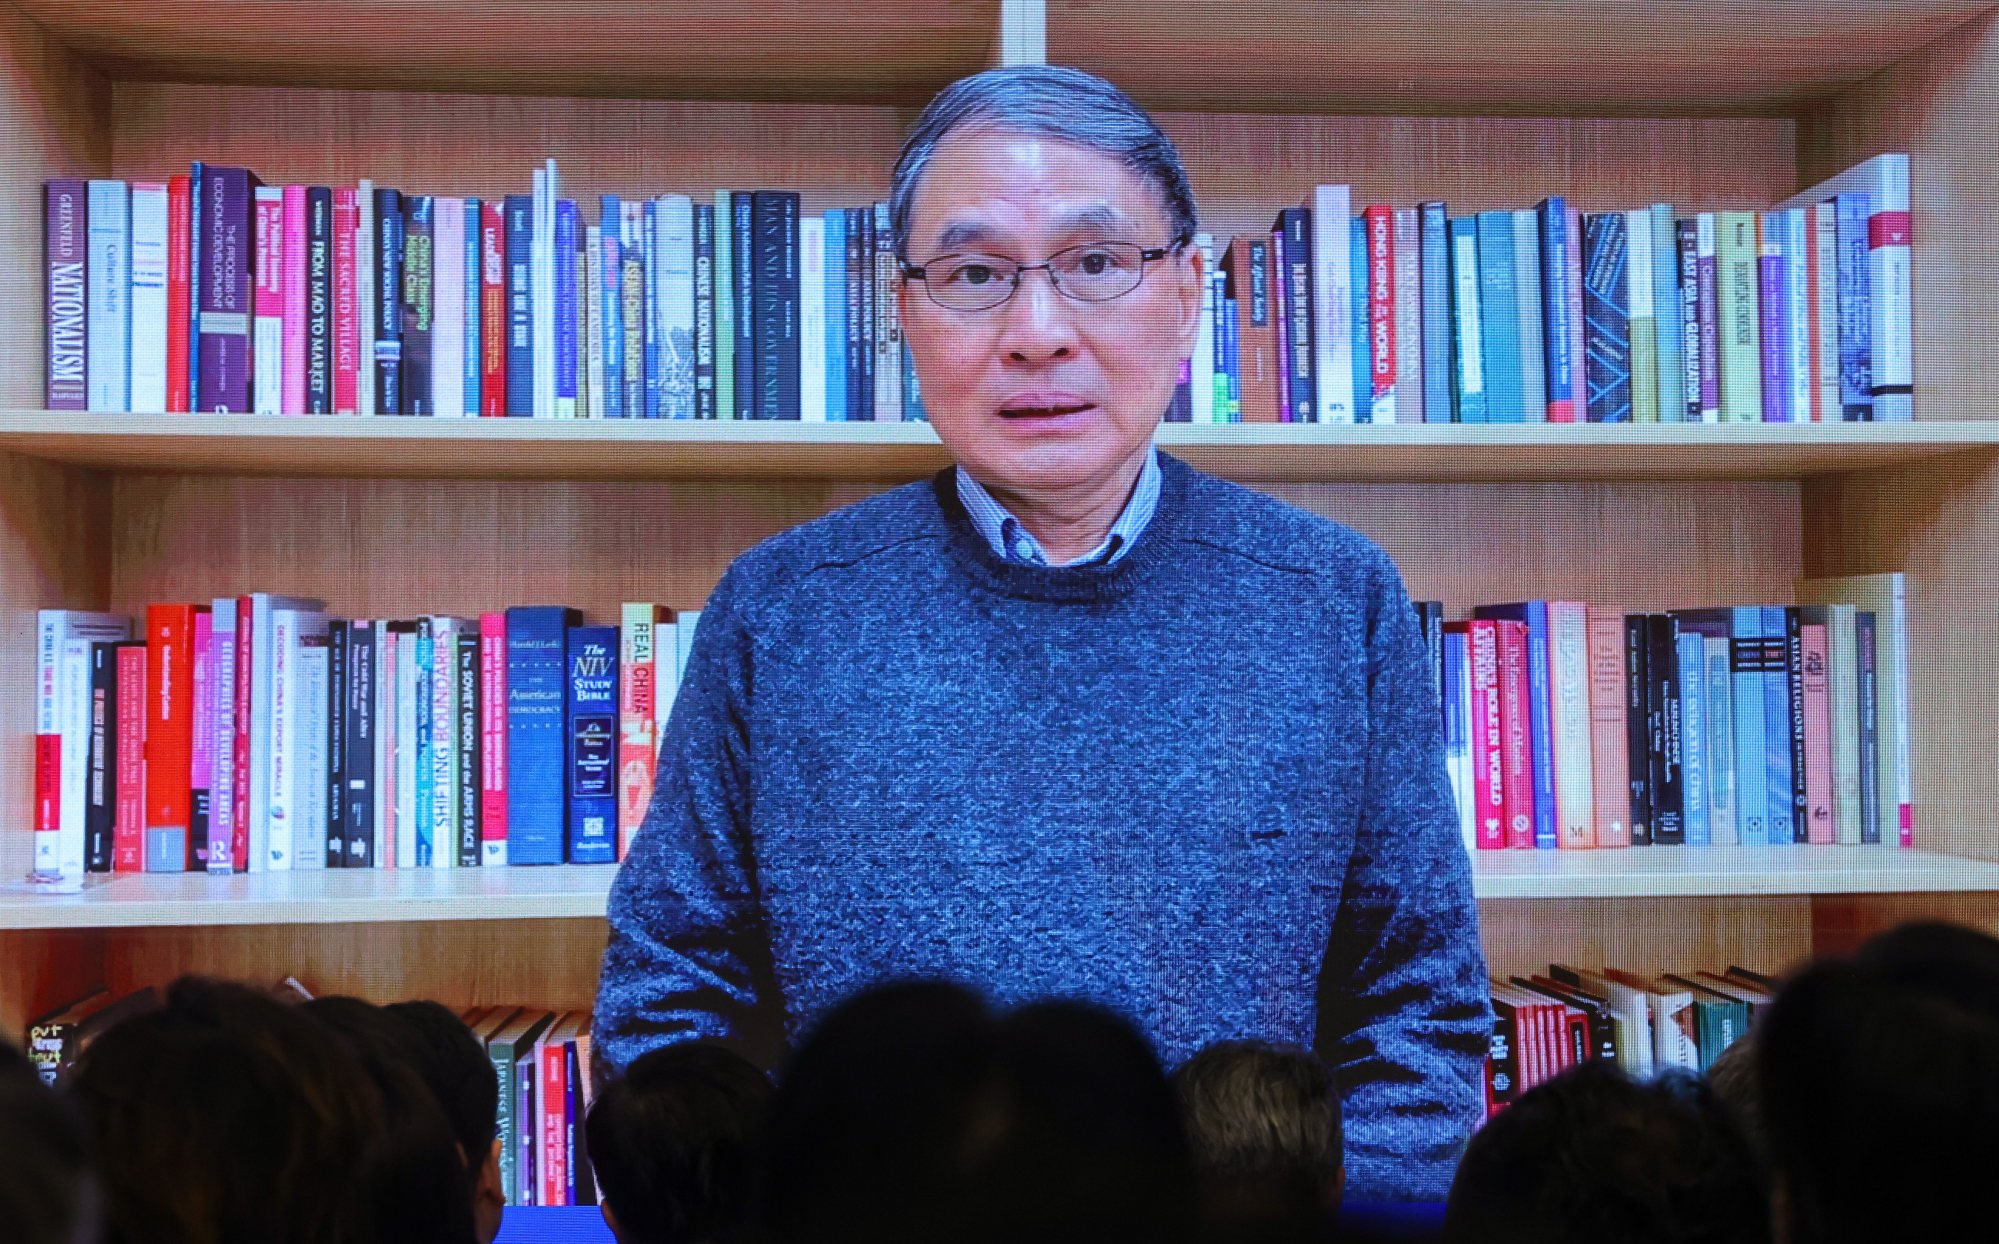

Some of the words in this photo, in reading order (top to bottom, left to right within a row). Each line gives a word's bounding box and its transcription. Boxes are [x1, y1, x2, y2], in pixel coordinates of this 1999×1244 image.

[213, 177, 223, 233] ECONOMIC
[742, 205, 751, 229] China's
[764, 199, 779, 236] MAN
[60, 194, 73, 256] GREENFELD
[226, 225, 235, 243] THE
[1374, 216, 1388, 257] HONG
[311, 241, 325, 276] FROM
[339, 232, 351, 259] THE
[406, 236, 417, 272] Middle
[418, 236, 430, 276] China's
[764, 245, 779, 278] AND
[1253, 246, 1263, 261] The
[106, 244, 117, 286] Culture
[213, 234, 223, 309] DEVELOPMENT
[226, 246, 235, 290] PROCESS
[697, 257, 711, 296] CHINESE
[1252, 264, 1263, 294] Affluent
[1376, 260, 1389, 300] KONG
[1568, 260, 1579, 294] After
[1684, 251, 1697, 277] EAST
[106, 289, 117, 312] Shift
[226, 293, 235, 309] OF
[311, 281, 325, 312] MAO
[339, 262, 351, 313] SACRED
[406, 275, 417, 304] Class
[416, 278, 430, 330] Emerging
[764, 284, 779, 311] HIS
[1685, 279, 1698, 303] ASIA
[52, 262, 83, 380] NATIONALISM
[311, 317, 325, 335] TO
[742, 296, 751, 337] Development
[849, 306, 858, 342] POLICY
[863, 305, 871, 341] POLICY
[1252, 297, 1264, 321] Society
[339, 318, 351, 371] VILLAGE
[697, 300, 711, 365] NATIONALISM
[1376, 321, 1389, 374] WORLD
[1570, 298, 1582, 366] Confucius
[308, 338, 324, 394] MARKET
[764, 318, 779, 421] GOVERNMEN
[1685, 322, 1700, 402] GLOBALIZATION
[275, 625, 285, 674] DECODING
[360, 645, 369, 660] The
[462, 652, 472, 667] The
[584, 644, 606, 656] The
[633, 623, 649, 662] REAL
[1474, 626, 1487, 690] AFFAIRS
[1486, 626, 1498, 685] CHINA'S
[1790, 636, 1801, 671] ASIAN
[220, 641, 233, 704] GEOGRAPHIES
[571, 657, 614, 677] NIV
[574, 678, 612, 691] STUDY
[1687, 671, 1699, 695] the
[275, 677, 285, 714] CHINA'S
[435, 630, 450, 742] BOUNDARIES
[462, 670, 473, 708] SOVIET
[509, 688, 561, 700] American
[576, 691, 611, 701] BIBLE
[633, 667, 649, 714] CHINA
[220, 714, 232, 725] OF
[1487, 688, 1499, 727] ROLE
[1792, 674, 1803, 740] RELIGIONS
[275, 718, 285, 753] EXPORT
[462, 712, 473, 750] UNION
[1488, 730, 1500, 746] IN
[218, 730, 232, 790] DEVELOPING
[275, 756, 284, 797] MIRACLE
[463, 753, 472, 768] and
[463, 770, 472, 783] the
[1489, 749, 1502, 805] WORLD
[1690, 756, 1702, 770] of
[435, 748, 449, 827] SHIFTING
[462, 787, 473, 816] ARMS
[1690, 773, 1704, 811] china
[218, 794, 230, 825] AREAS
[462, 819, 473, 848] RACE
